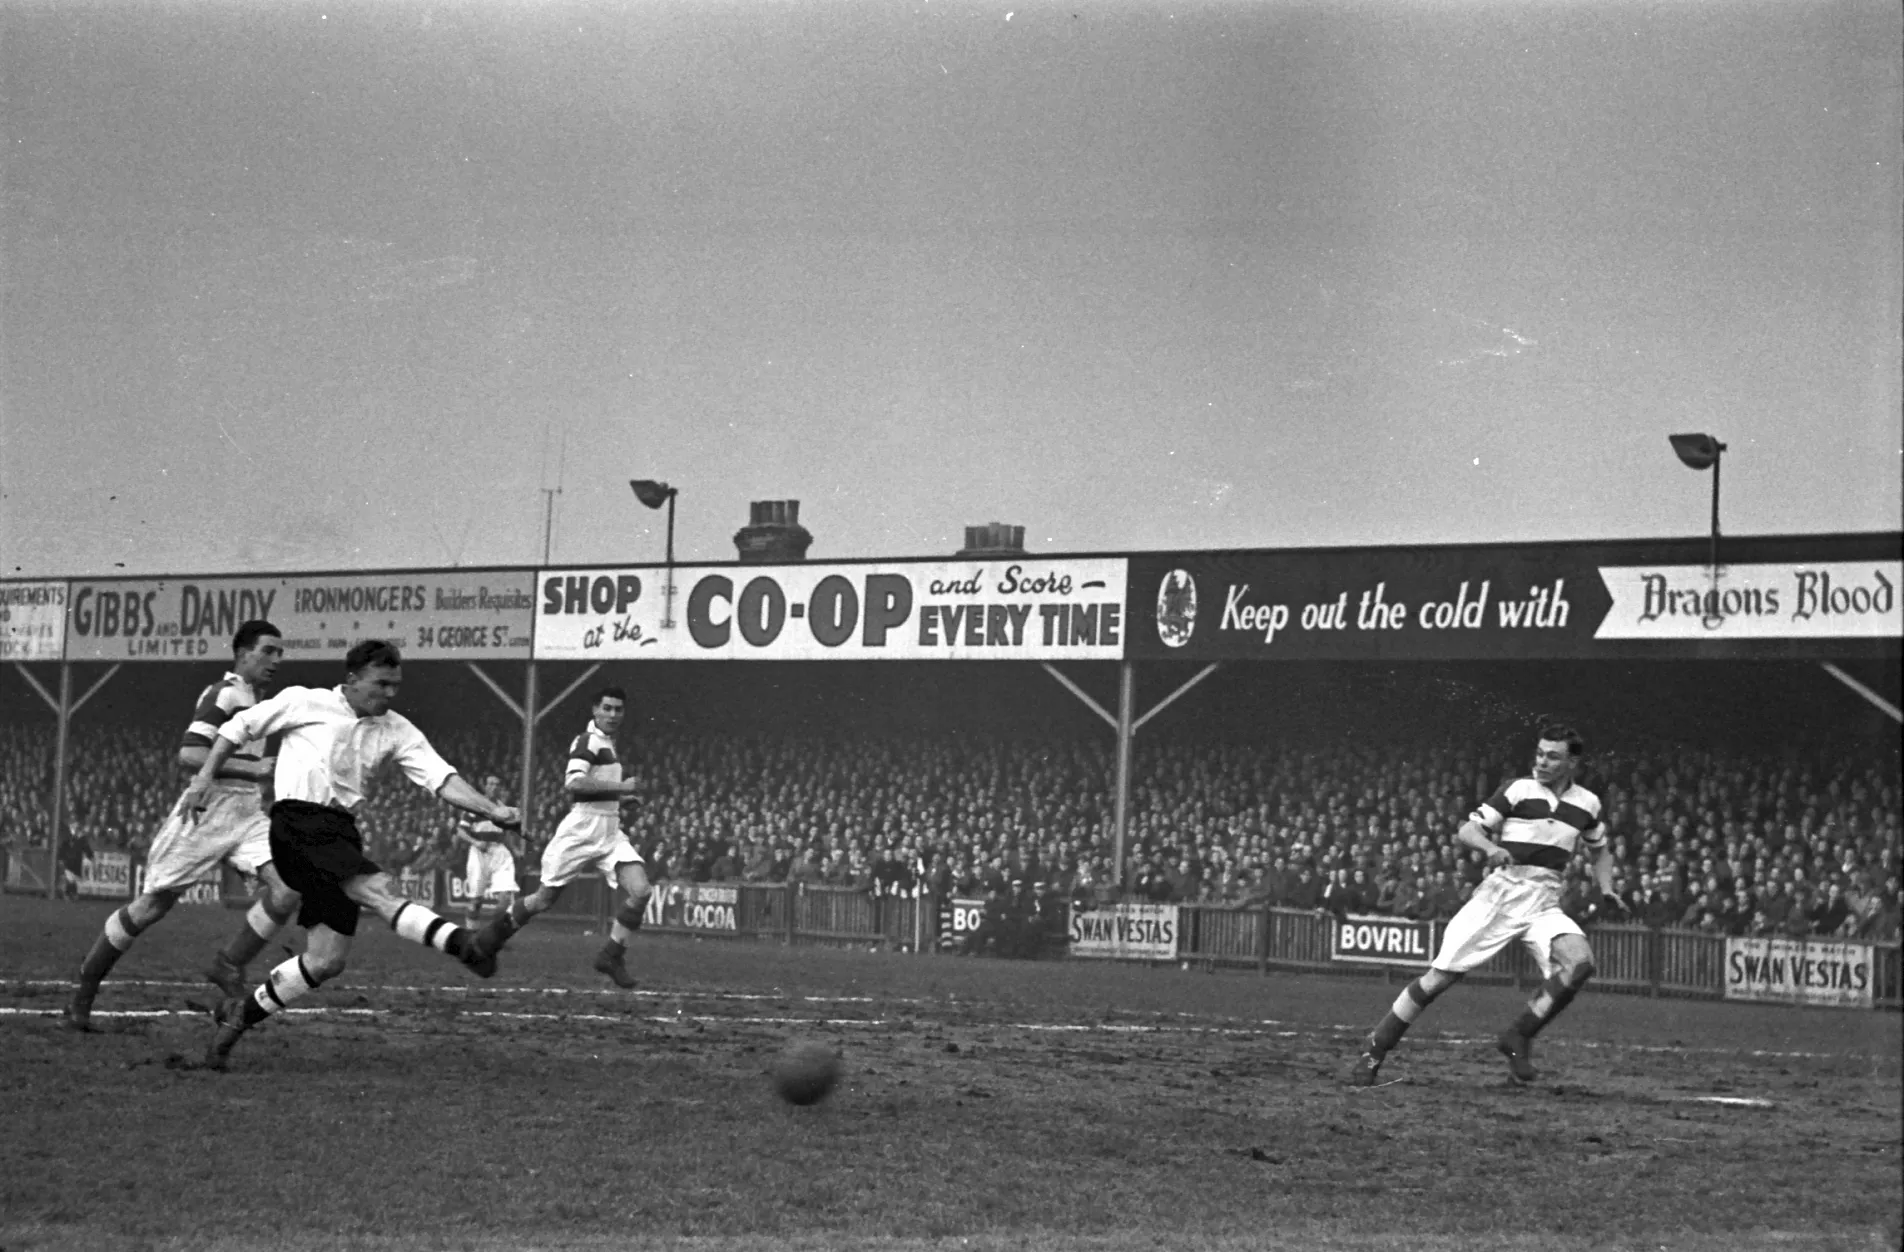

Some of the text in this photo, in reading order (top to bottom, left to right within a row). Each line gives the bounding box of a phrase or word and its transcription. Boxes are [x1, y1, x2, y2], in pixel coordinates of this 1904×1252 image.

[543, 574, 642, 615] SHOP
[929, 568, 984, 595] and
[997, 564, 1073, 596] Score
[74, 584, 277, 637] GIBBS AND DANDY
[294, 585, 533, 613] IRONMONGERS Builders Requisites
[686, 573, 913, 649] CO-OP
[1219, 577, 1571, 645] Keep out the cold with
[1636, 569, 1894, 632] Dragons Blood
[417, 626, 434, 648] 34
[437, 626, 488, 648] GEORGE
[583, 624, 605, 649] at
[918, 602, 1121, 647] EVERY TIME
[127, 638, 209, 657] LIMITED
[683, 902, 737, 931] COCOA
[1072, 913, 1173, 945] SWAN VESTAS
[1340, 924, 1426, 955] BOVRIL
[1729, 950, 1868, 990] SWAN VESTAS
